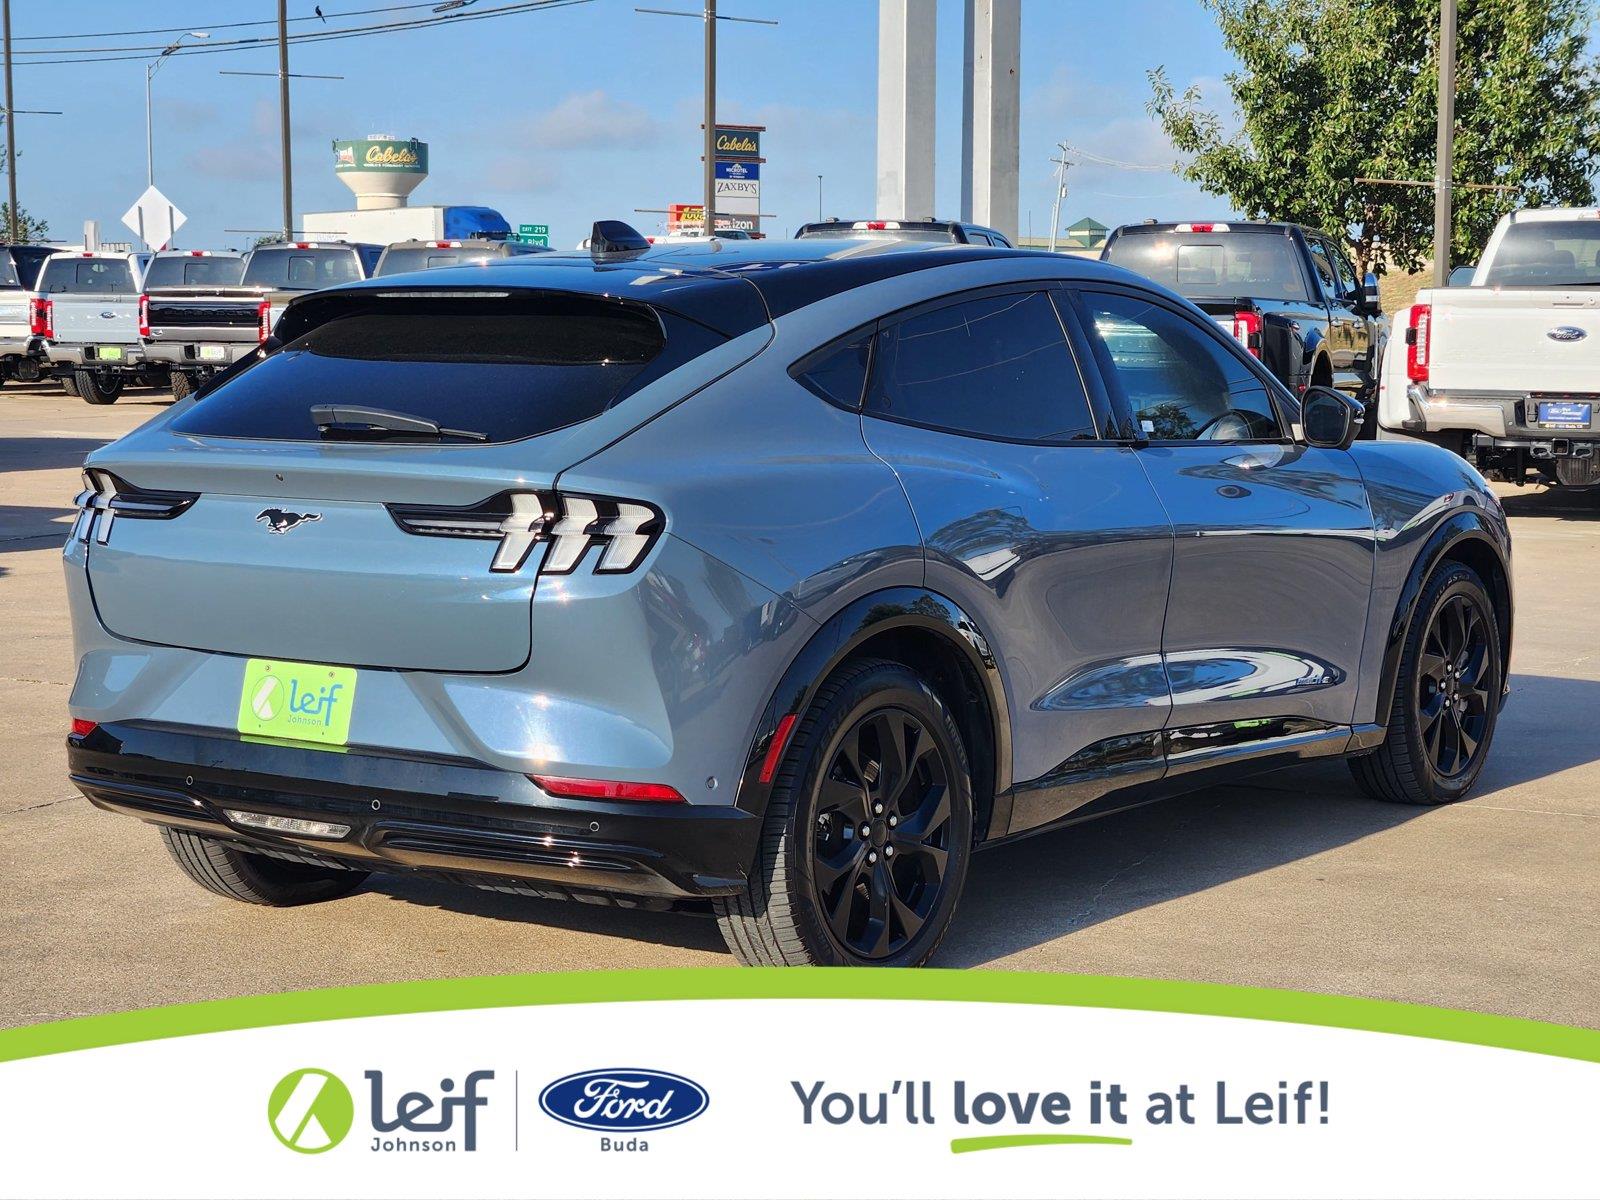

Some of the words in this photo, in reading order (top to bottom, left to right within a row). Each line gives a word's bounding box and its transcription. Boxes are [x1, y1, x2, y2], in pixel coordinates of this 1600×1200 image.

[716, 135, 757, 152] Cabela's
[717, 182, 757, 194] ZAXBY'S
[534, 226, 546, 234] 219
[289, 678, 344, 727] leif
[287, 714, 322, 727] Johnson
